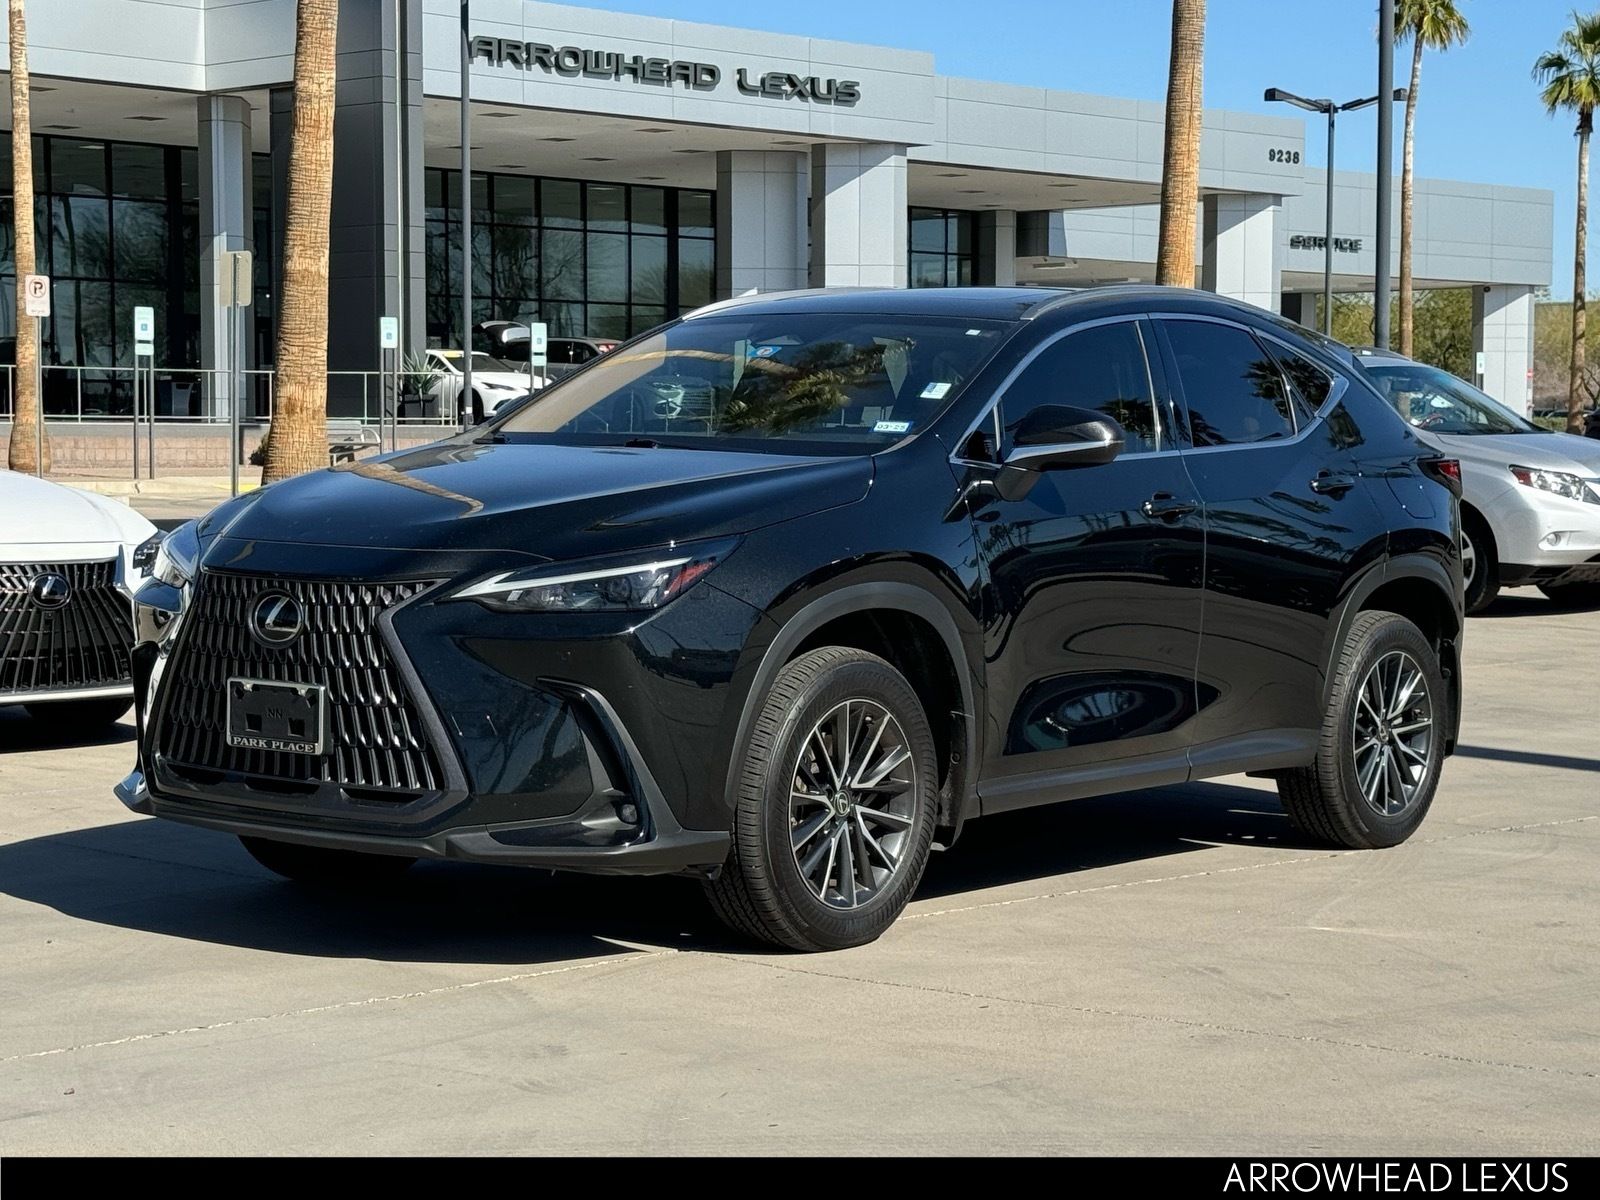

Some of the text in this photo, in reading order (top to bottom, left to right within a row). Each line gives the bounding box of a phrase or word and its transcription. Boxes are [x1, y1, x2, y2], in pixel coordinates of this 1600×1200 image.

[471, 35, 862, 105] ARROWHEAD LEXUS
[1268, 148, 1300, 164] 9238
[1289, 235, 1363, 252] SERICE
[232, 736, 315, 753] PARK PLACE
